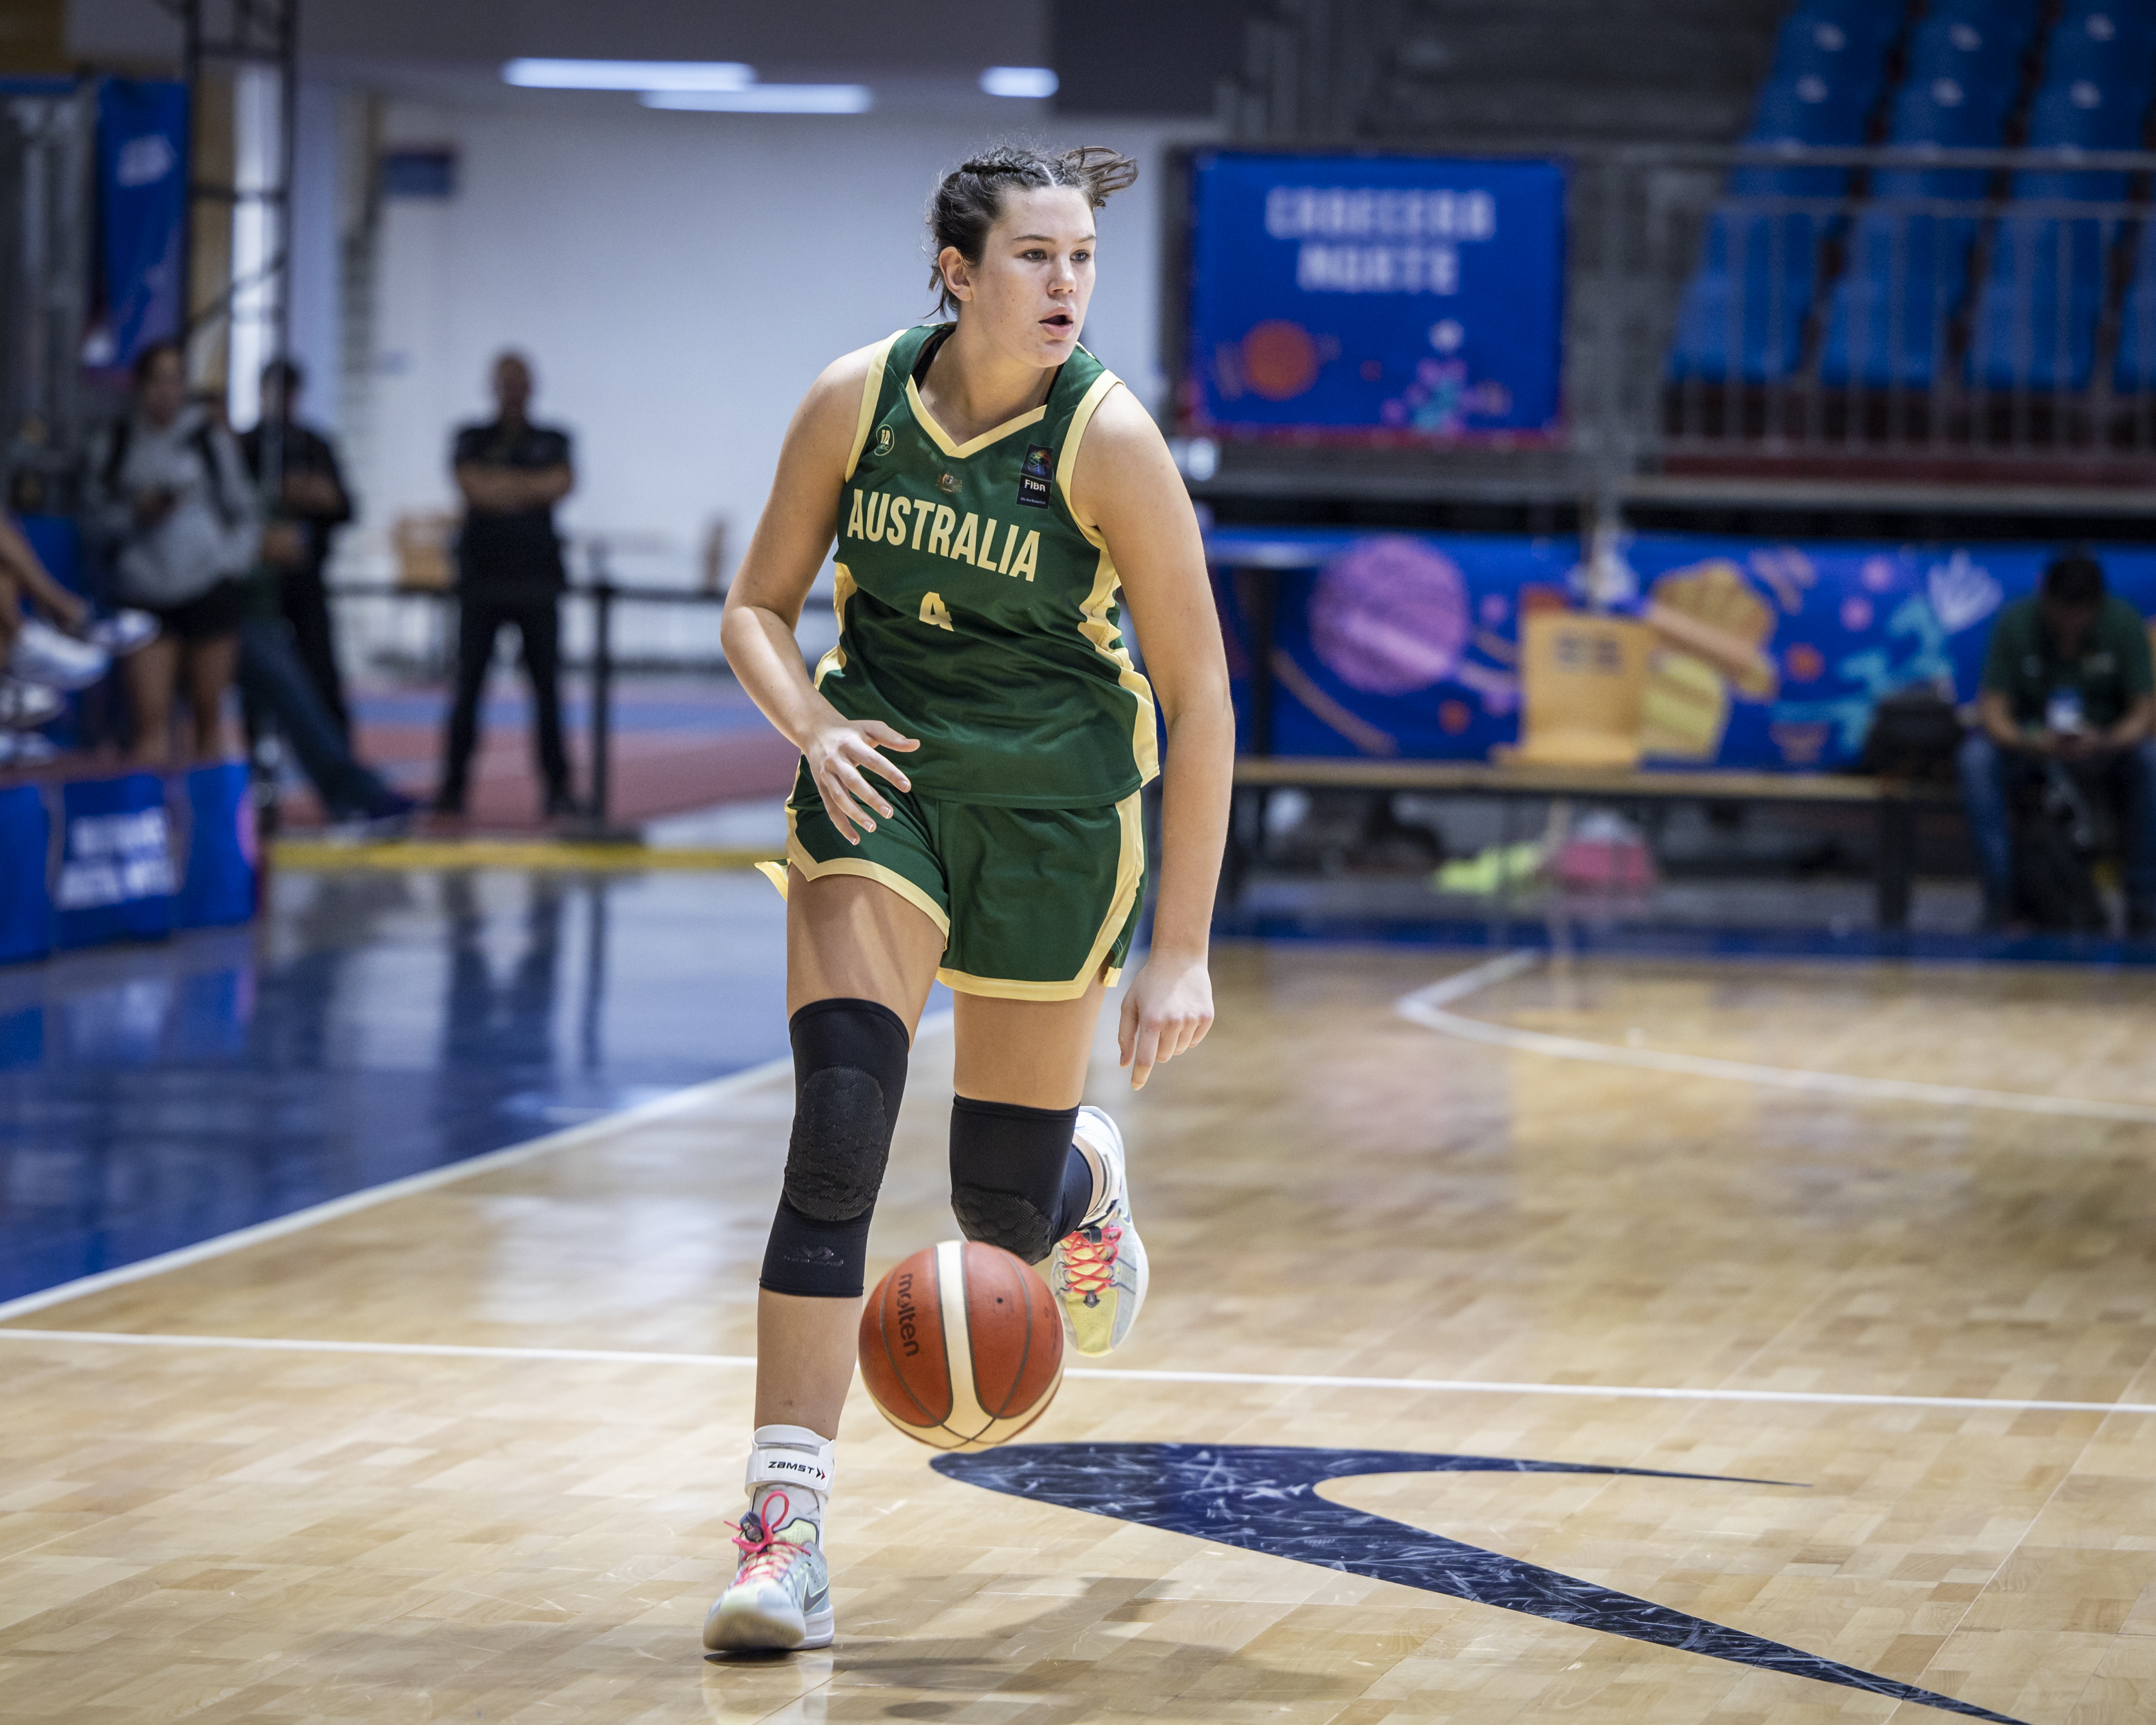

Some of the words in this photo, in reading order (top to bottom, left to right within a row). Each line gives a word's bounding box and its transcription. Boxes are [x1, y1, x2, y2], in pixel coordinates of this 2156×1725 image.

[1025, 479, 1046, 492] FIBA
[847, 489, 1040, 582] AUSTRALIA
[897, 1273, 919, 1357] molten
